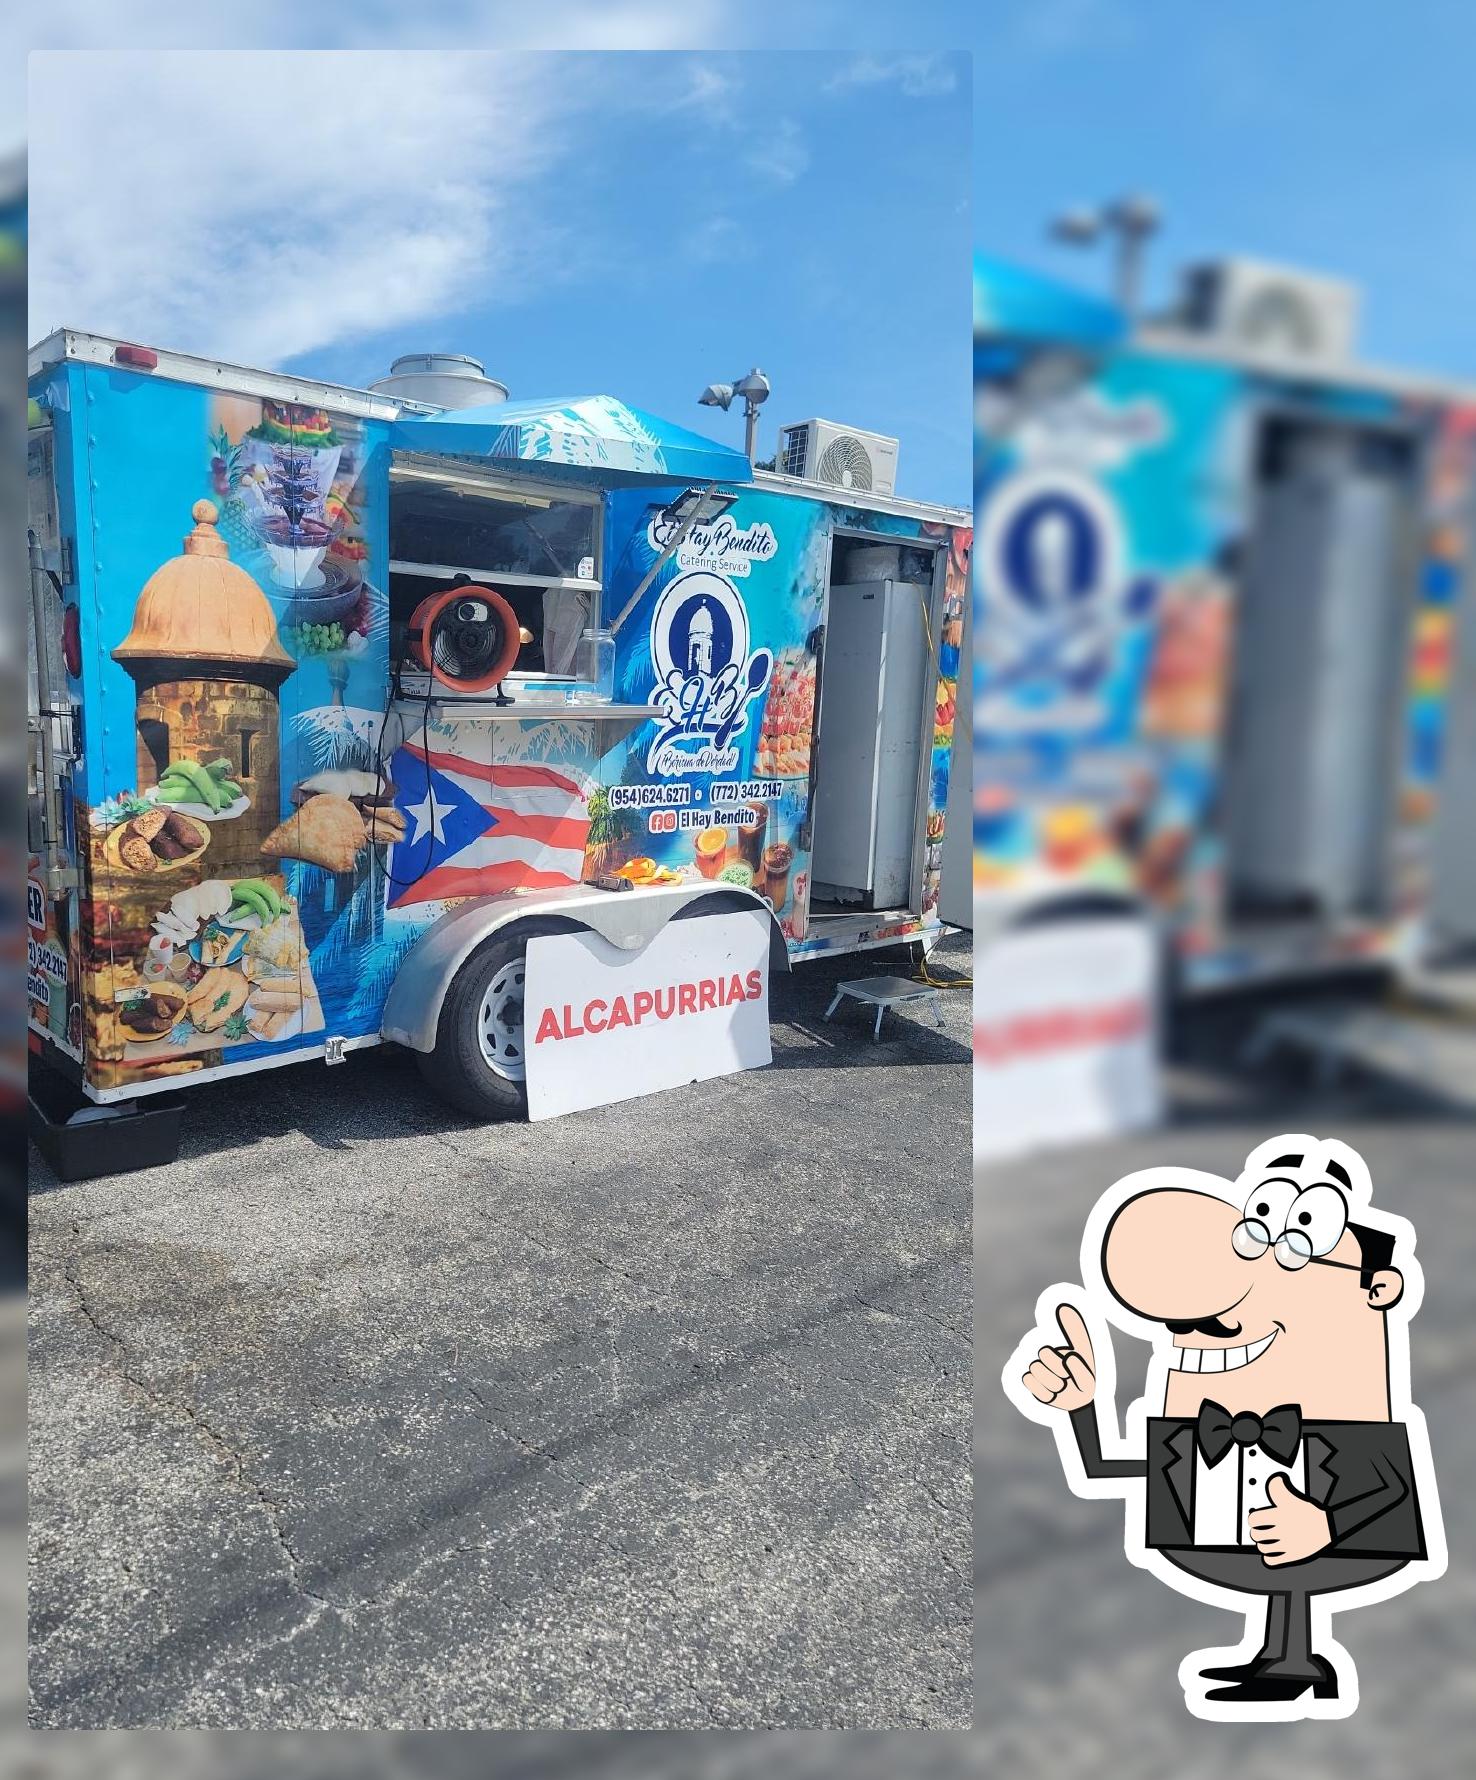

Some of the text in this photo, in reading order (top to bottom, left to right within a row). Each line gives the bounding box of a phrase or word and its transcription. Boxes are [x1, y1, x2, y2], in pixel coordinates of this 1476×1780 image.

[714, 521, 771, 556] Bendito
[680, 553, 748, 572] Catering Service
[610, 783, 782, 806] (954)624.6271 (772) 342.2147
[681, 808, 755, 829] El Hay Bendito
[534, 969, 763, 1044] ALCAPURRIAS
